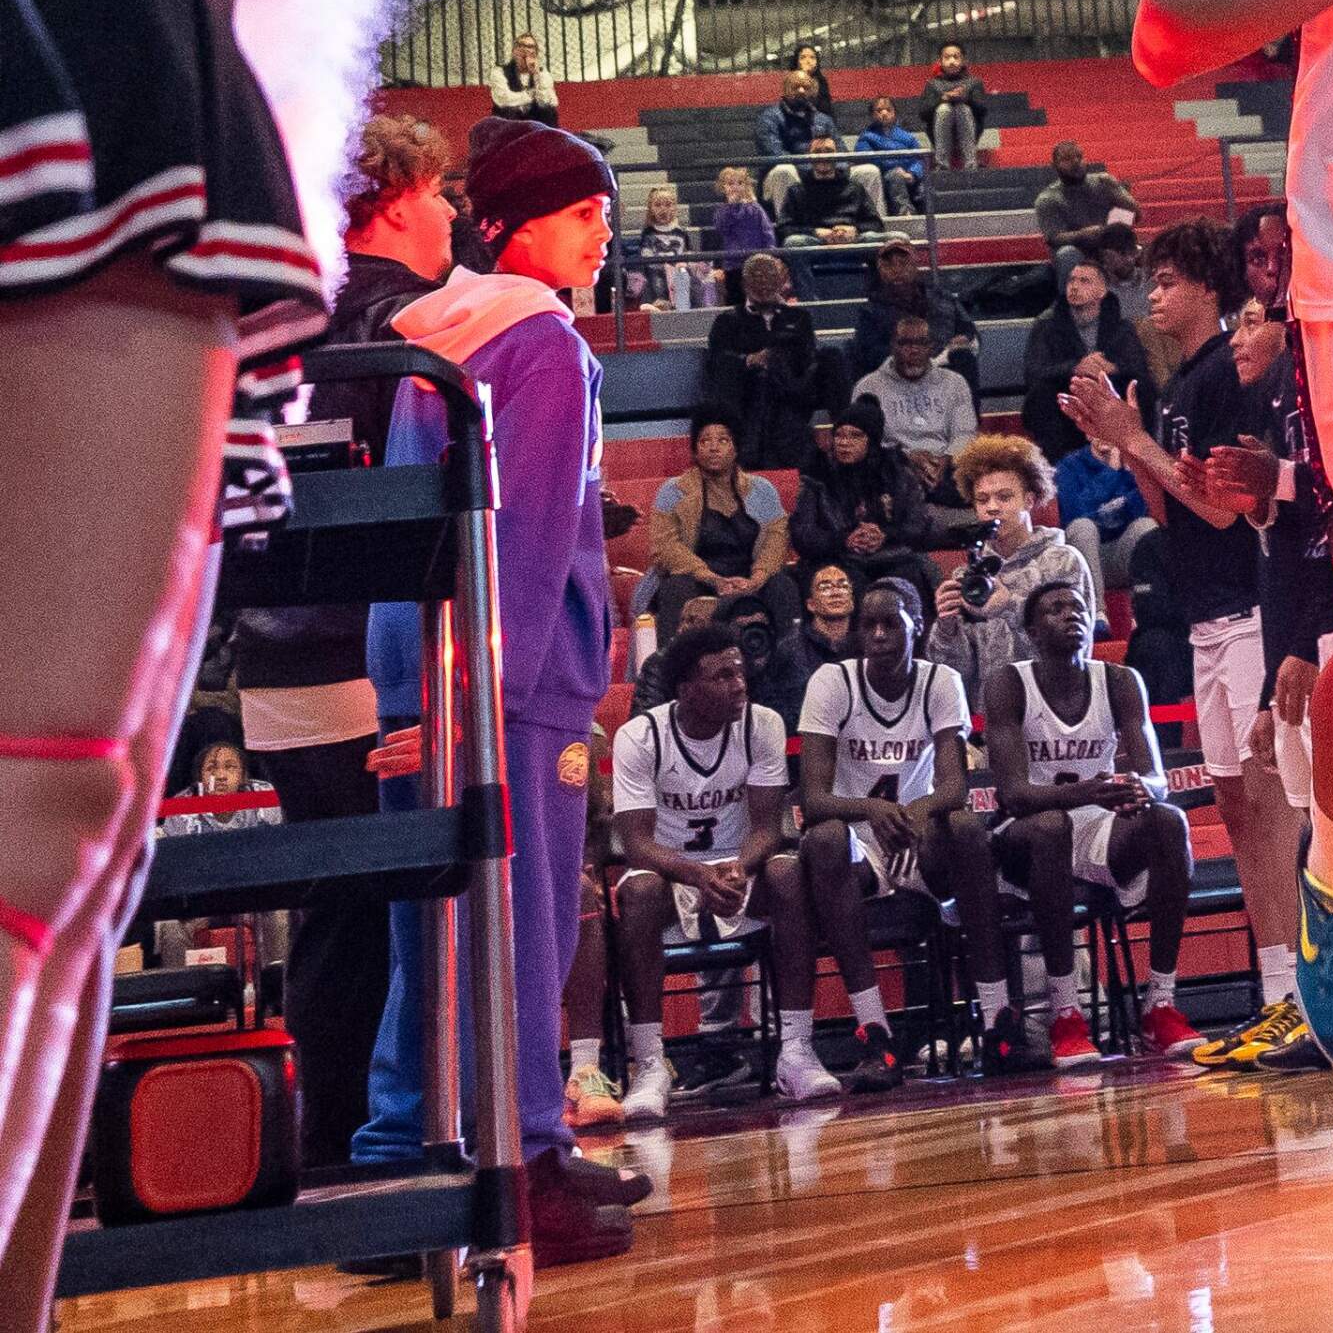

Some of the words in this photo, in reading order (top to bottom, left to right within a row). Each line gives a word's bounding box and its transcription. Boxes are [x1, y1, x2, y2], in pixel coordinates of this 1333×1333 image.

[848, 738, 927, 762] FALCONS
[662, 788, 745, 811] FALCONS
[683, 816, 718, 852] 3
